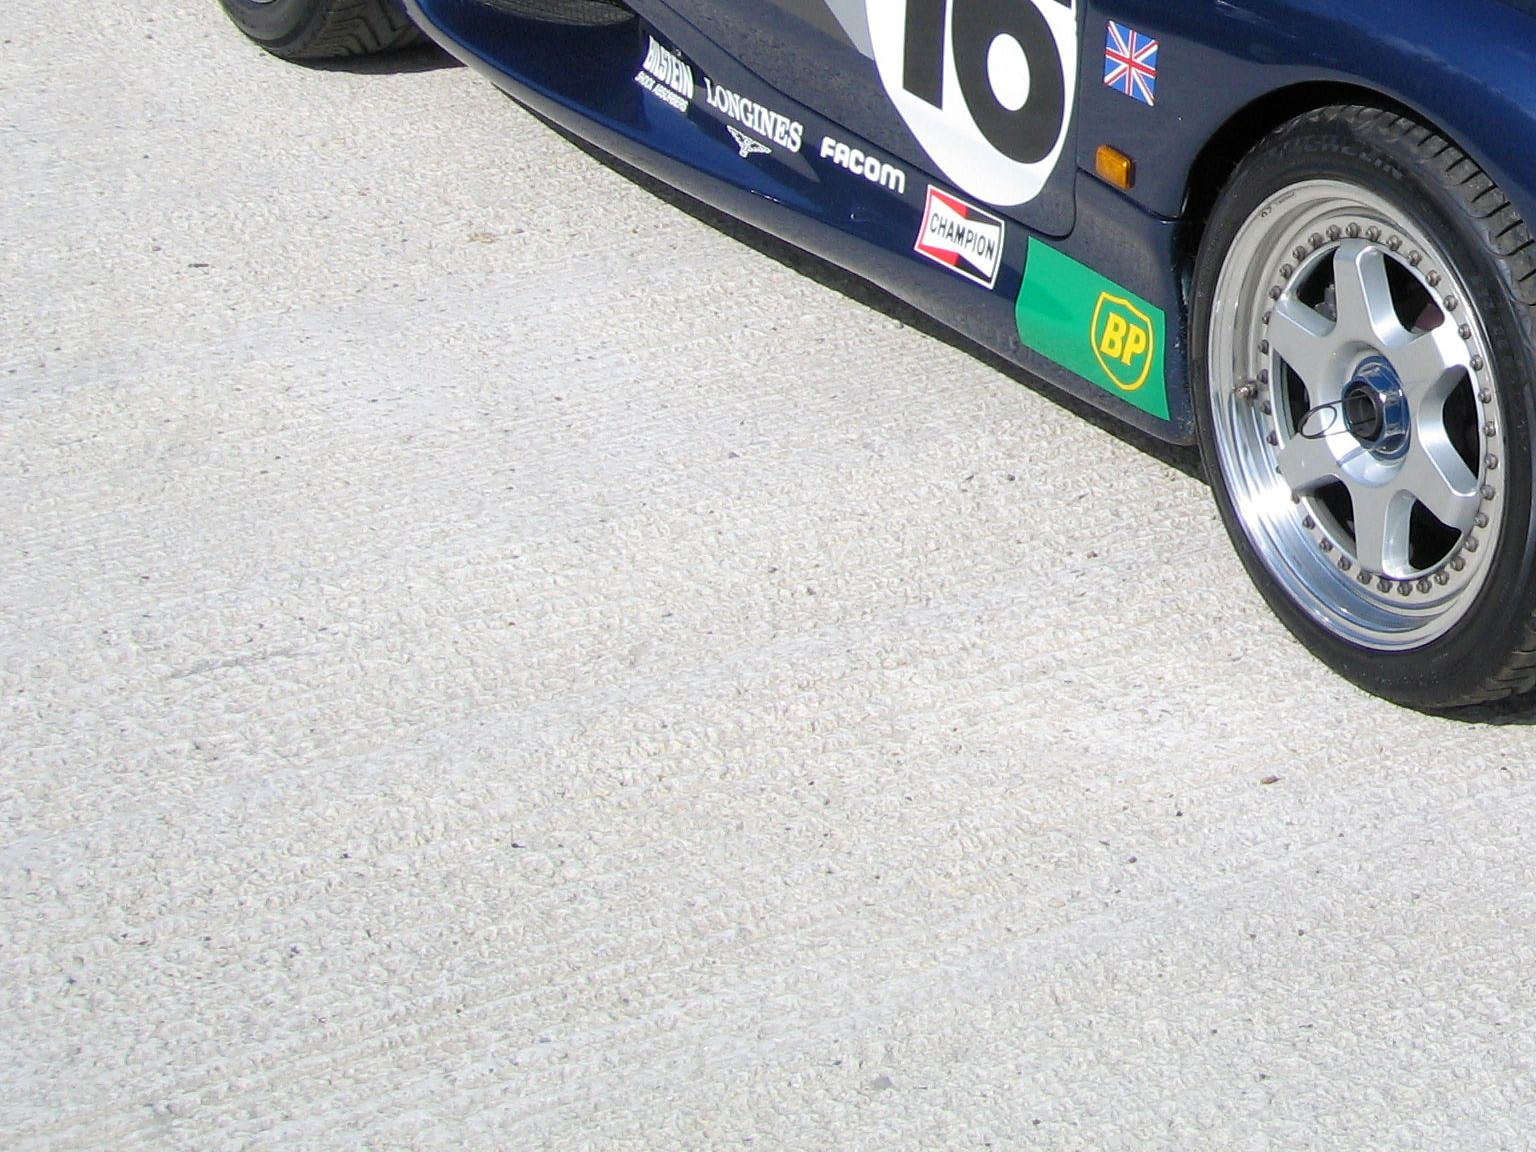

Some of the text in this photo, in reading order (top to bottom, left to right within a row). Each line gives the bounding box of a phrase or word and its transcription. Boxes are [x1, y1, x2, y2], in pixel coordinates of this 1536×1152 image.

[703, 76, 803, 153] LONGINES
[820, 136, 905, 194] FACOM
[929, 212, 996, 261] CHAMPION
[1100, 310, 1147, 366] BP
